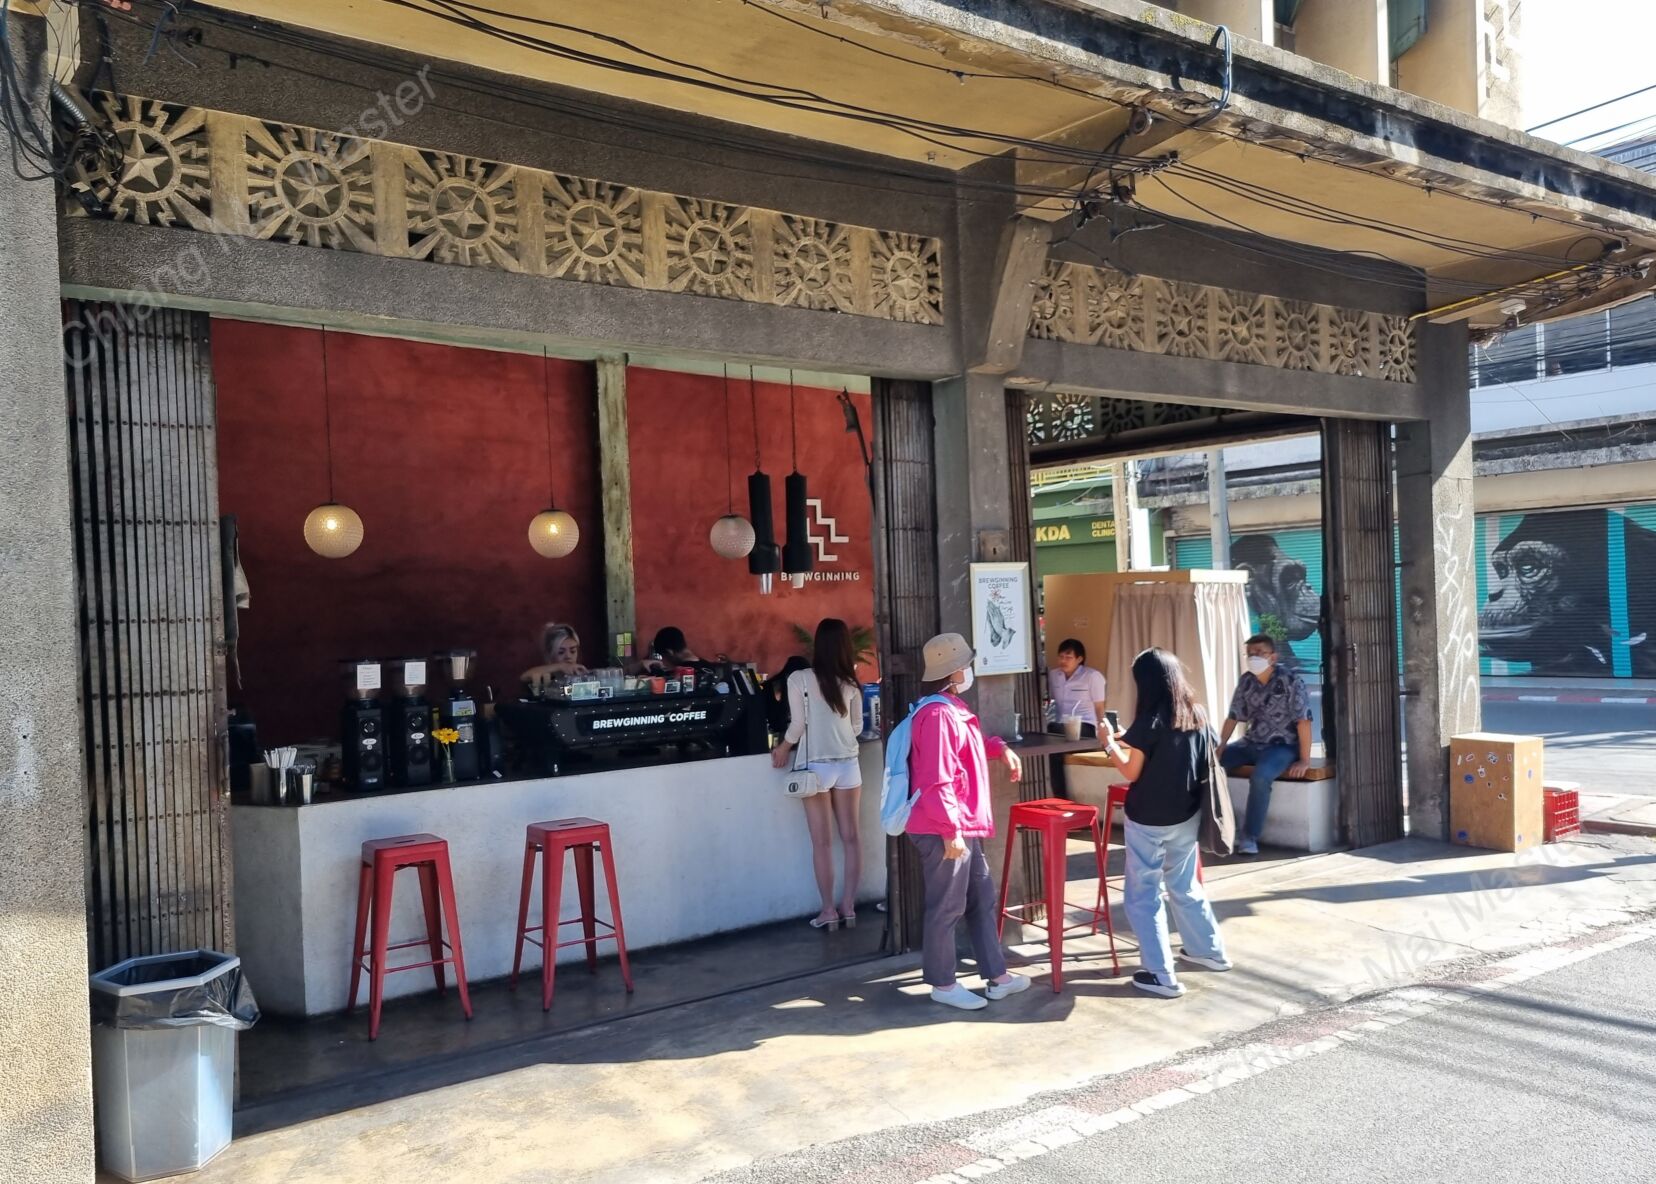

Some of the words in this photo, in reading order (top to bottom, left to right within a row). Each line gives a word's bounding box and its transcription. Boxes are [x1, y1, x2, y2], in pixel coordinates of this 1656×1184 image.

[1091, 520, 1115, 529] DENTA
[1034, 524, 1071, 542] KDA
[780, 572, 860, 581] BWGINNING
[592, 714, 665, 729] BREWGINNING
[669, 711, 707, 722] COFFEE
